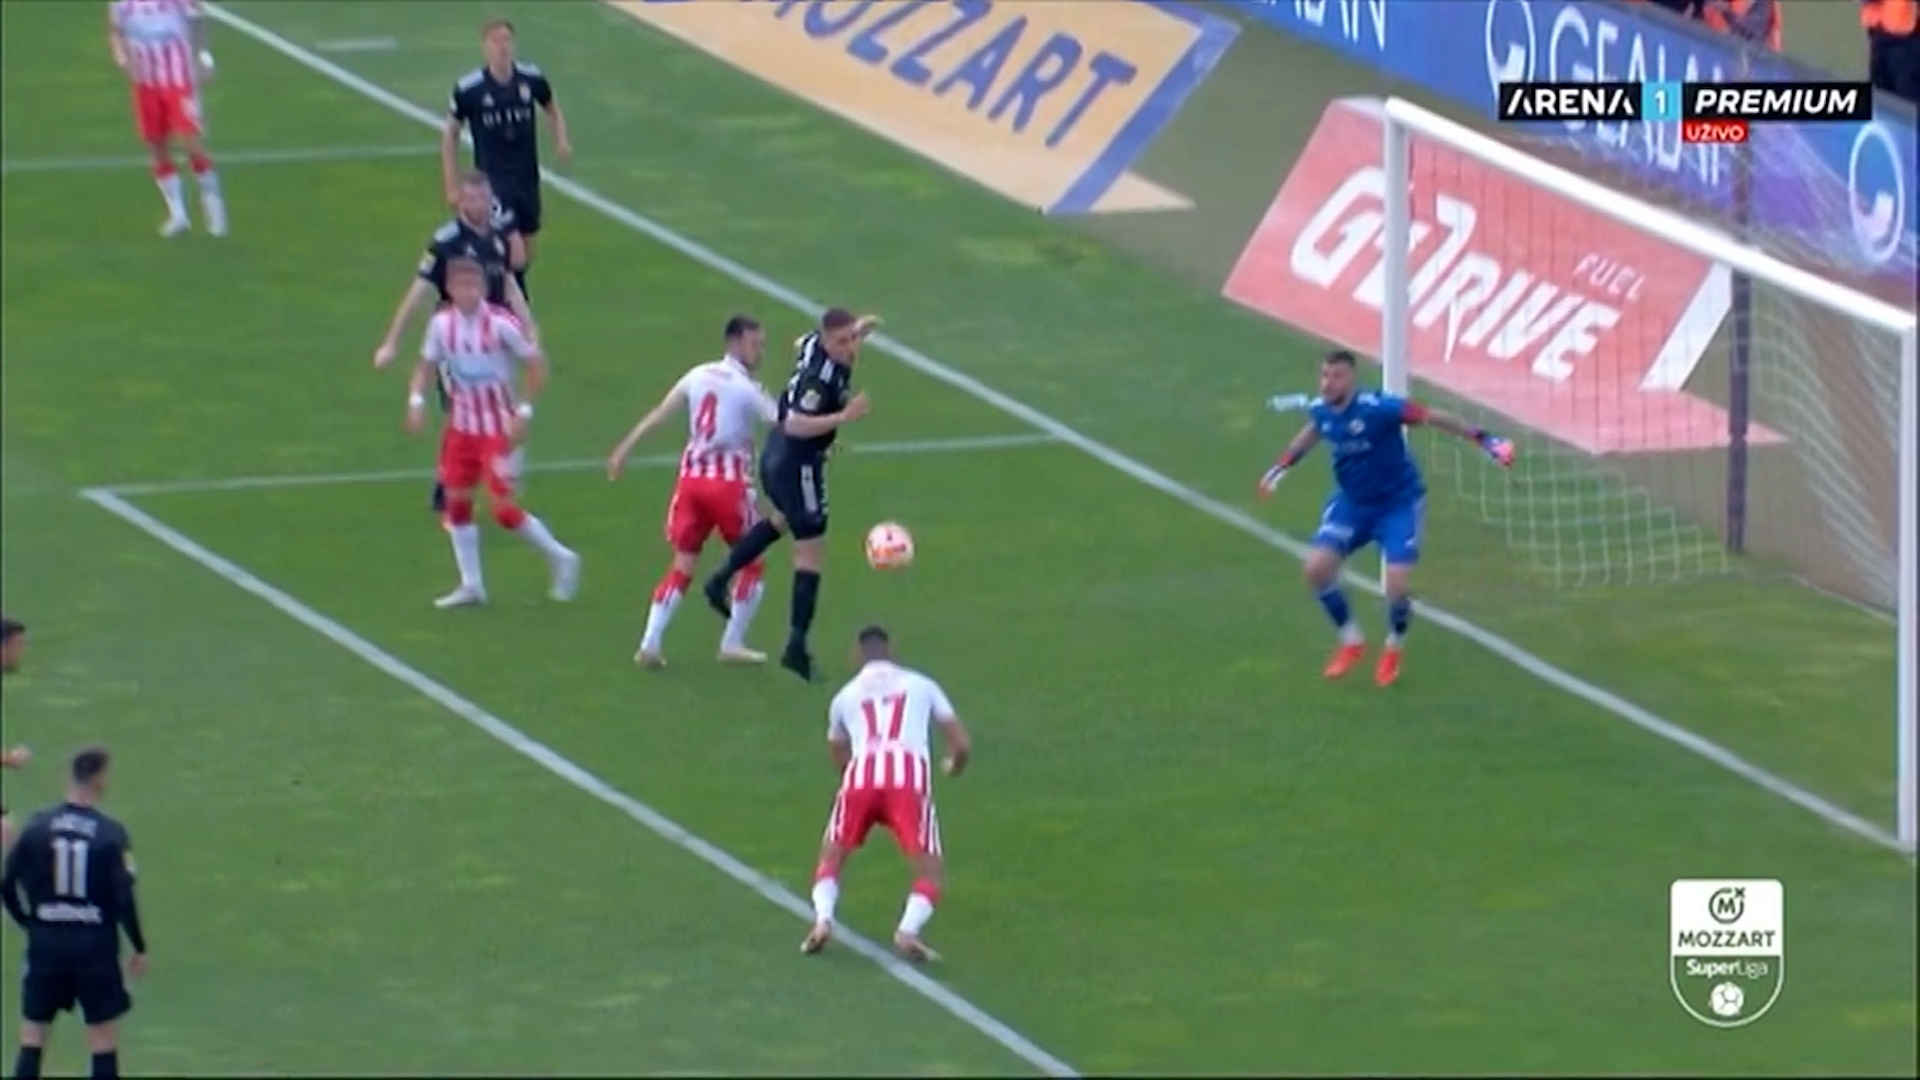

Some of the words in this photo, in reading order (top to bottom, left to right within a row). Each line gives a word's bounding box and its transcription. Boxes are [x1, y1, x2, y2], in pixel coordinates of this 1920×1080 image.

[772, 0, 1137, 148] ZZART
[1572, 252, 1646, 301] FUEL
[861, 691, 908, 742] 17
[53, 837, 89, 898] 11
